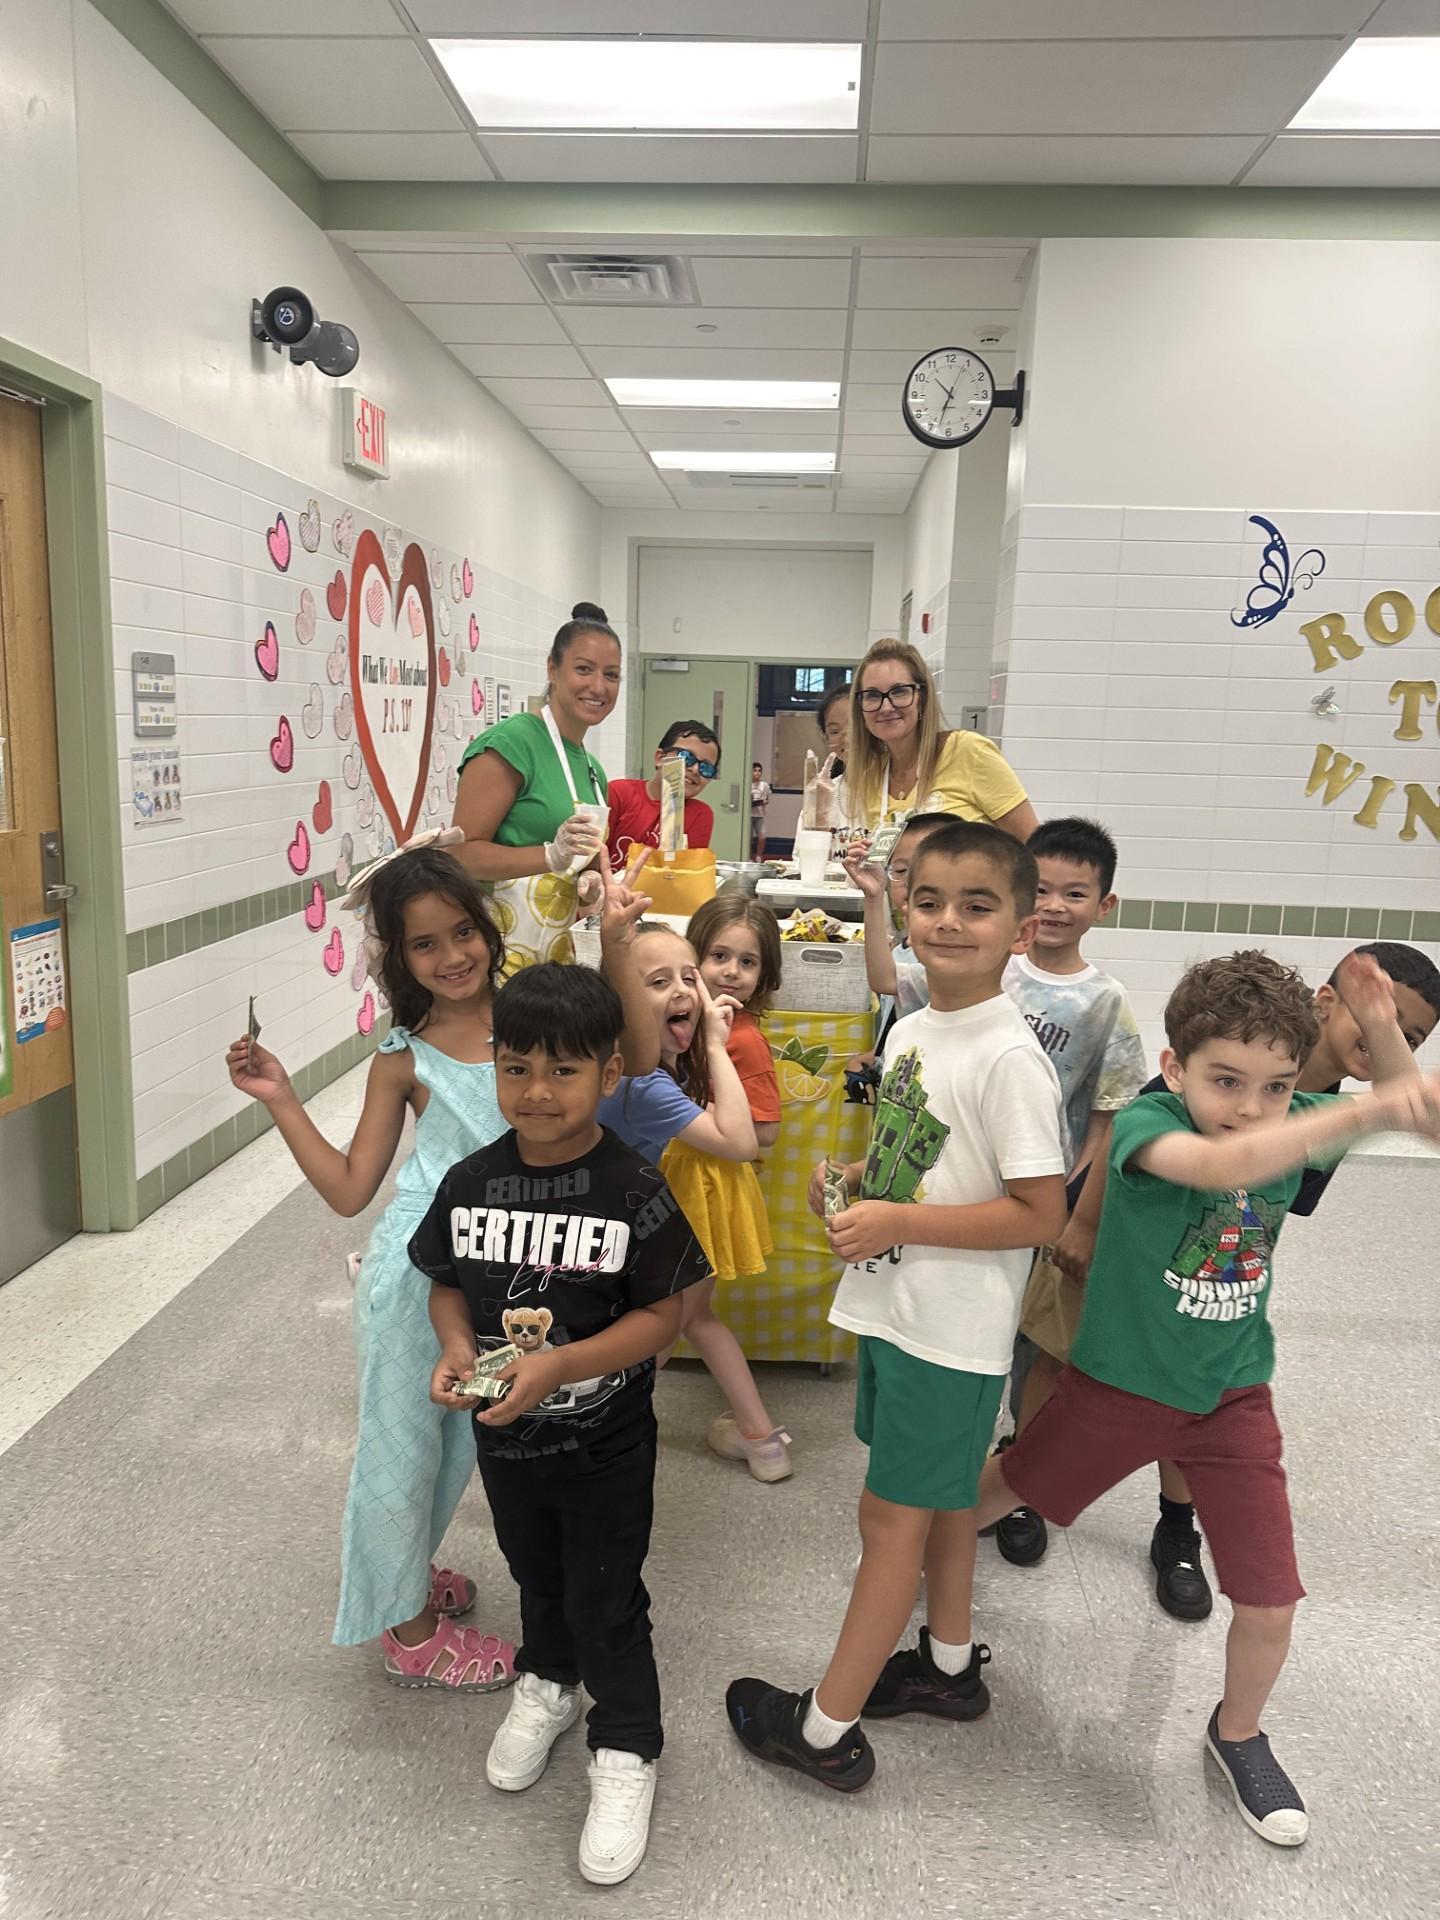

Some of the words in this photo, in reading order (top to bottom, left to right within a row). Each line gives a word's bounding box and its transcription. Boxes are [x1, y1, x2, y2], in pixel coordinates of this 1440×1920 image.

[946, 354, 957, 363] 12
[966, 359, 971, 367] 1
[927, 360, 936, 368] 11
[914, 373, 926, 382] 10
[978, 372, 985, 381] 2
[912, 391, 918, 399] 9
[981, 390, 988, 399] 3
[915, 409, 922, 419] 8
[976, 409, 983, 417] 4
[928, 423, 934, 431] 7
[963, 423, 970, 432] 5
[361, 398, 385, 466] EXIT
[945, 428, 952, 437] 6
[1389, 680, 1440, 741] T
[968, 713, 978, 729] 1
[485, 1167, 591, 1206] CERTIFIED
[450, 1206, 631, 1273] CERTIFIED
[507, 1245, 609, 1300] Legend
[1175, 1295, 1258, 1322] MODE!
